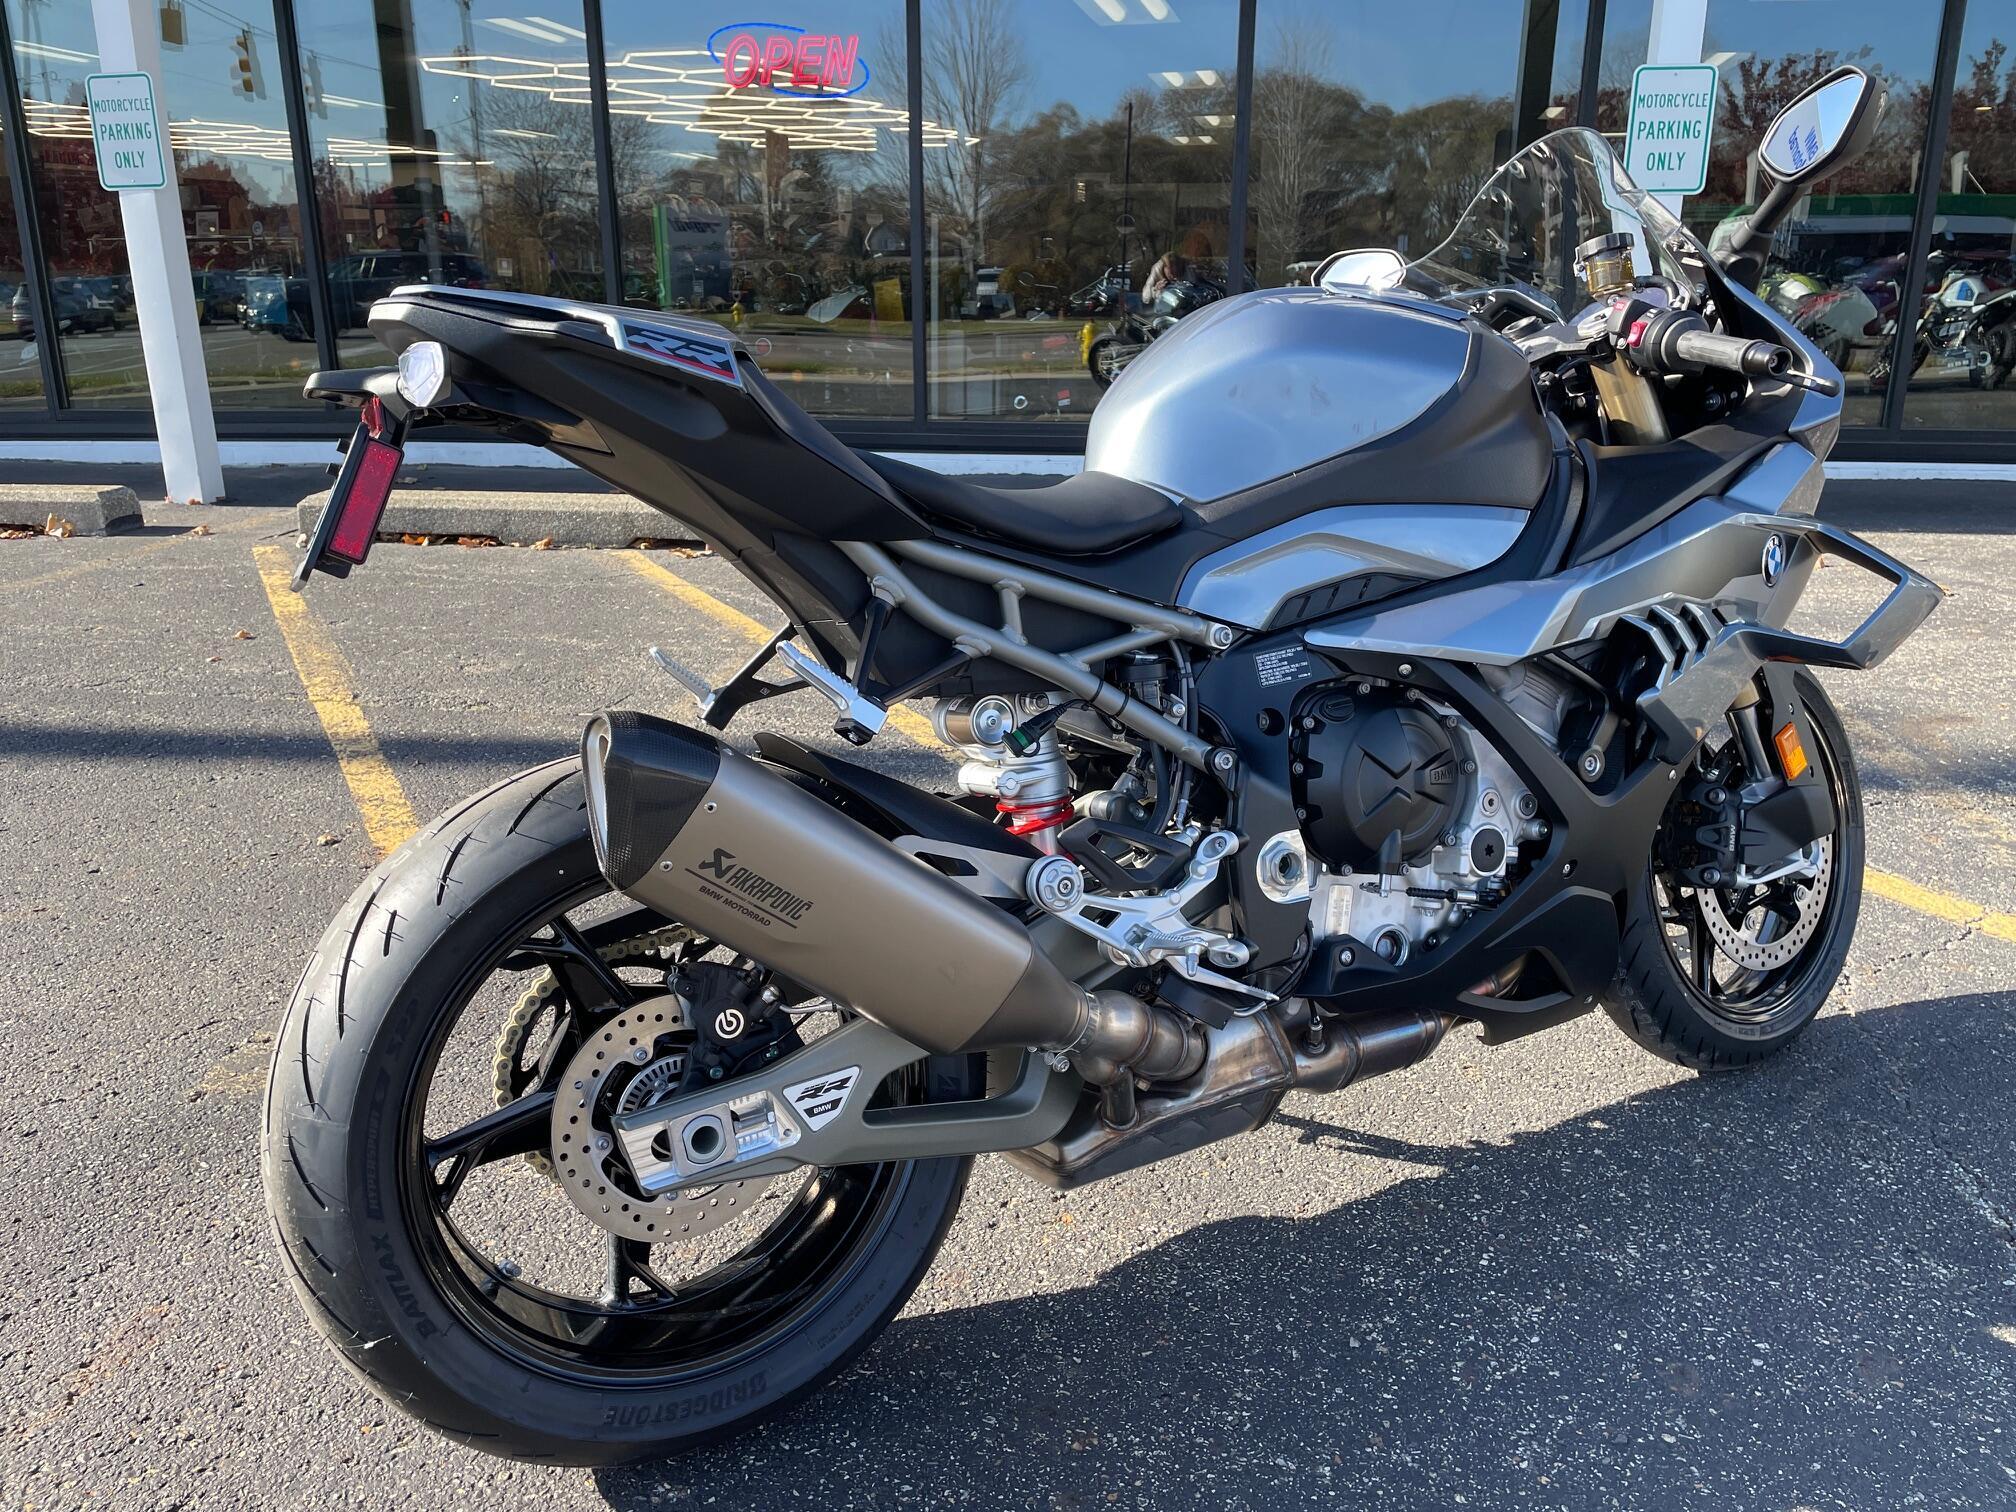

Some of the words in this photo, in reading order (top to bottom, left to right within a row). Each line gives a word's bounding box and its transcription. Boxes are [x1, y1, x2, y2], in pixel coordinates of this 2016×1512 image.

[724, 33, 859, 89] OPEN
[93, 98, 151, 113] MOTORCYCLE
[1637, 93, 1709, 109] MOTORCYCLE
[100, 122, 152, 141] PARKING
[1637, 120, 1702, 140] PARKING
[114, 151, 145, 169] ONLY
[1646, 151, 1686, 171] ONLY
[627, 331, 731, 369] RR
[699, 885, 724, 902] BMW
[722, 897, 771, 927] MOTORRAD
[795, 1075, 853, 1103] RR
[813, 1102, 832, 1114] BMW
[603, 1370, 768, 1426] BRIDGESTONE
